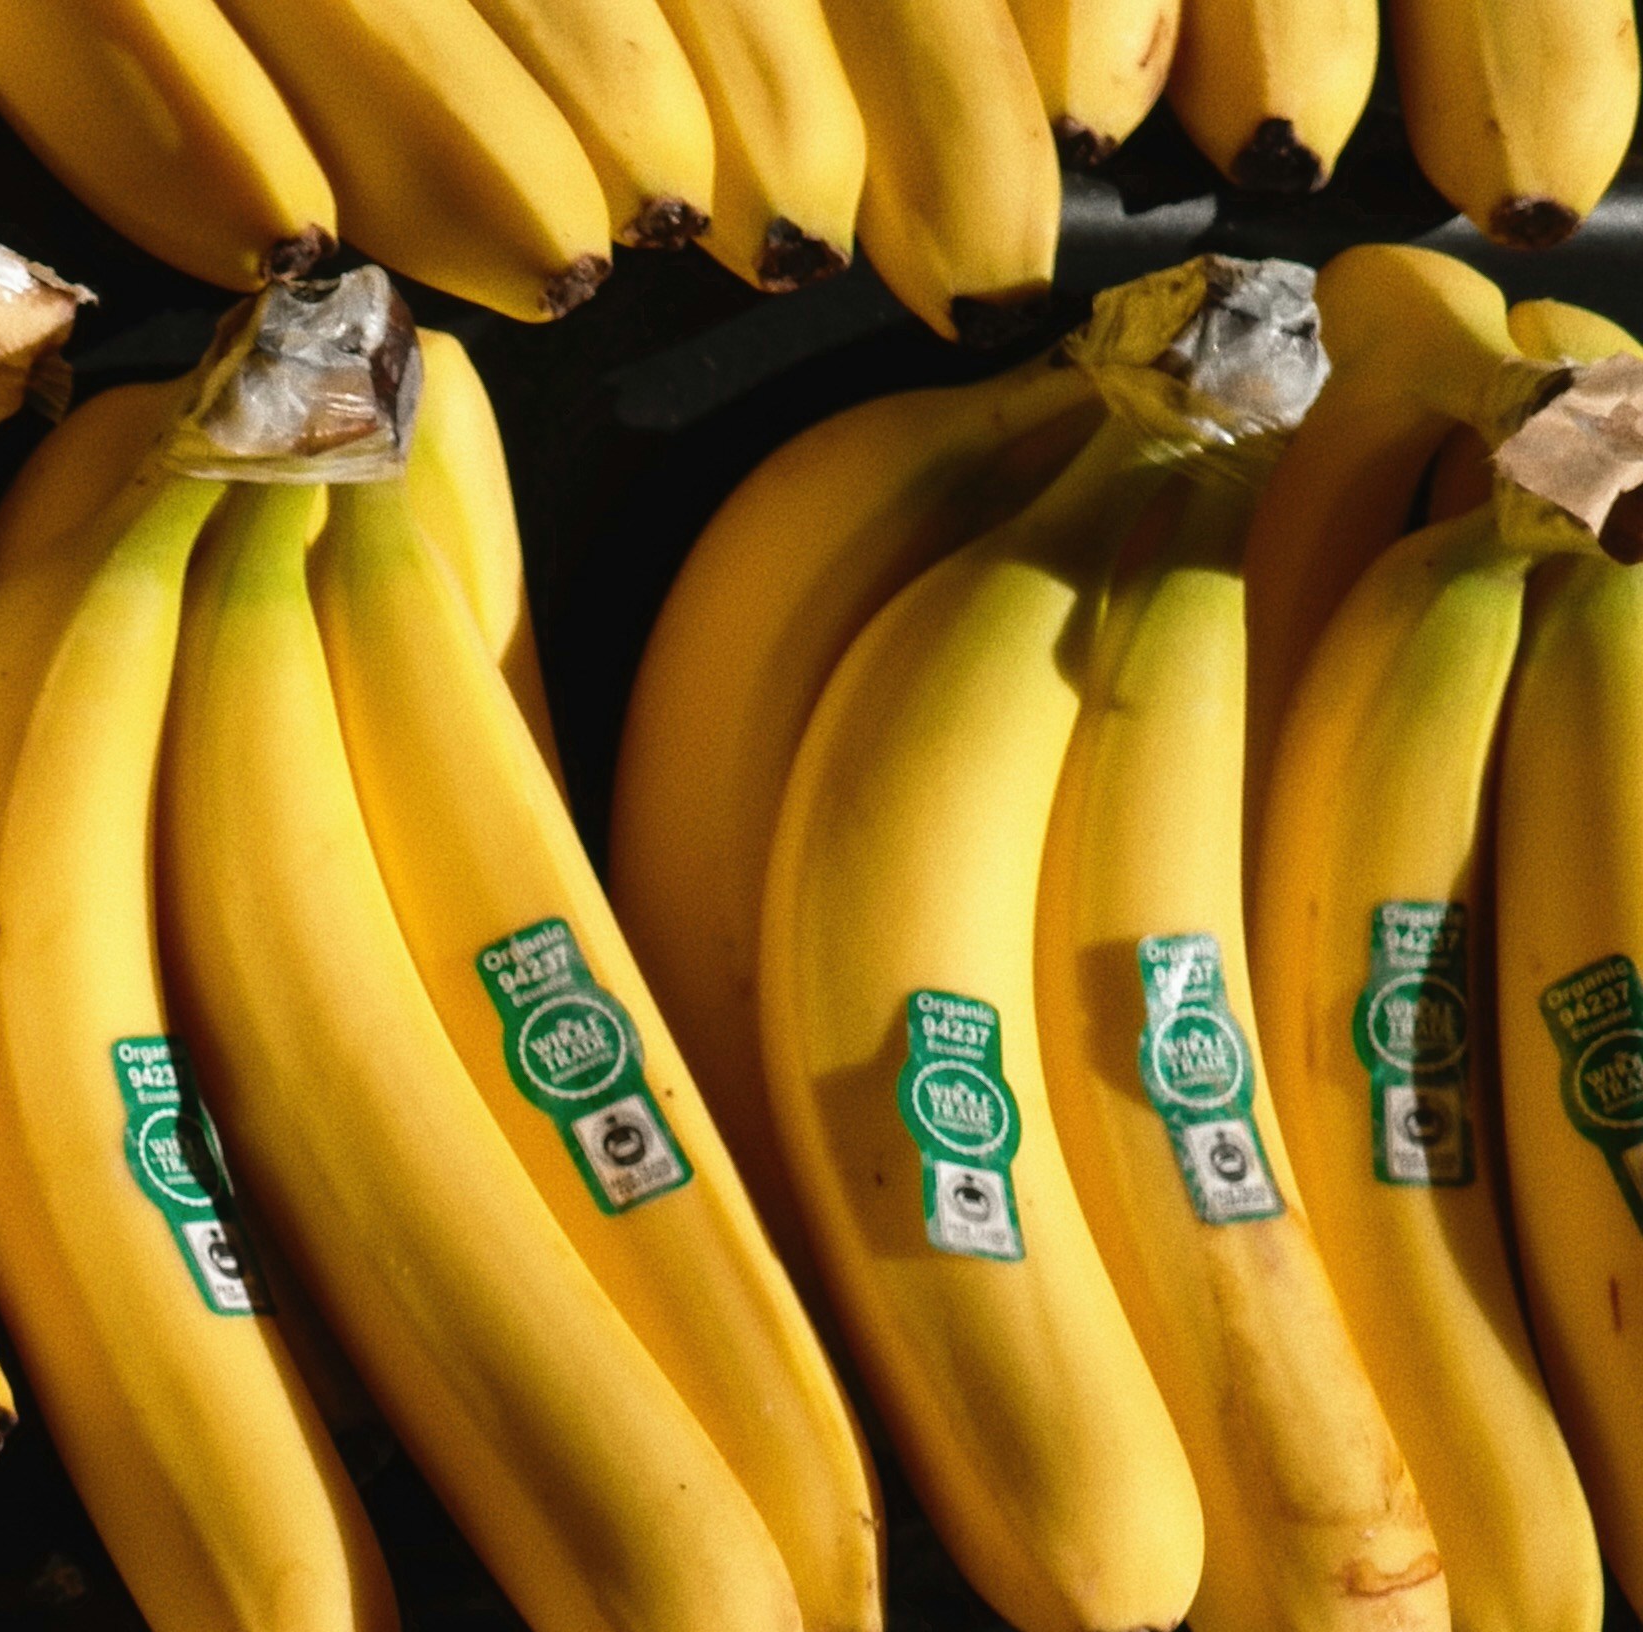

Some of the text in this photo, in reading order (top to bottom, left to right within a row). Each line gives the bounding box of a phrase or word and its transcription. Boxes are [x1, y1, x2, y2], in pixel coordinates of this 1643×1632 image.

[497, 945, 571, 994] 94237
[917, 993, 995, 1026] Organic
[1559, 981, 1630, 1027] 94237
[921, 1015, 990, 1047] 94237
[127, 1064, 177, 1088] 9423
